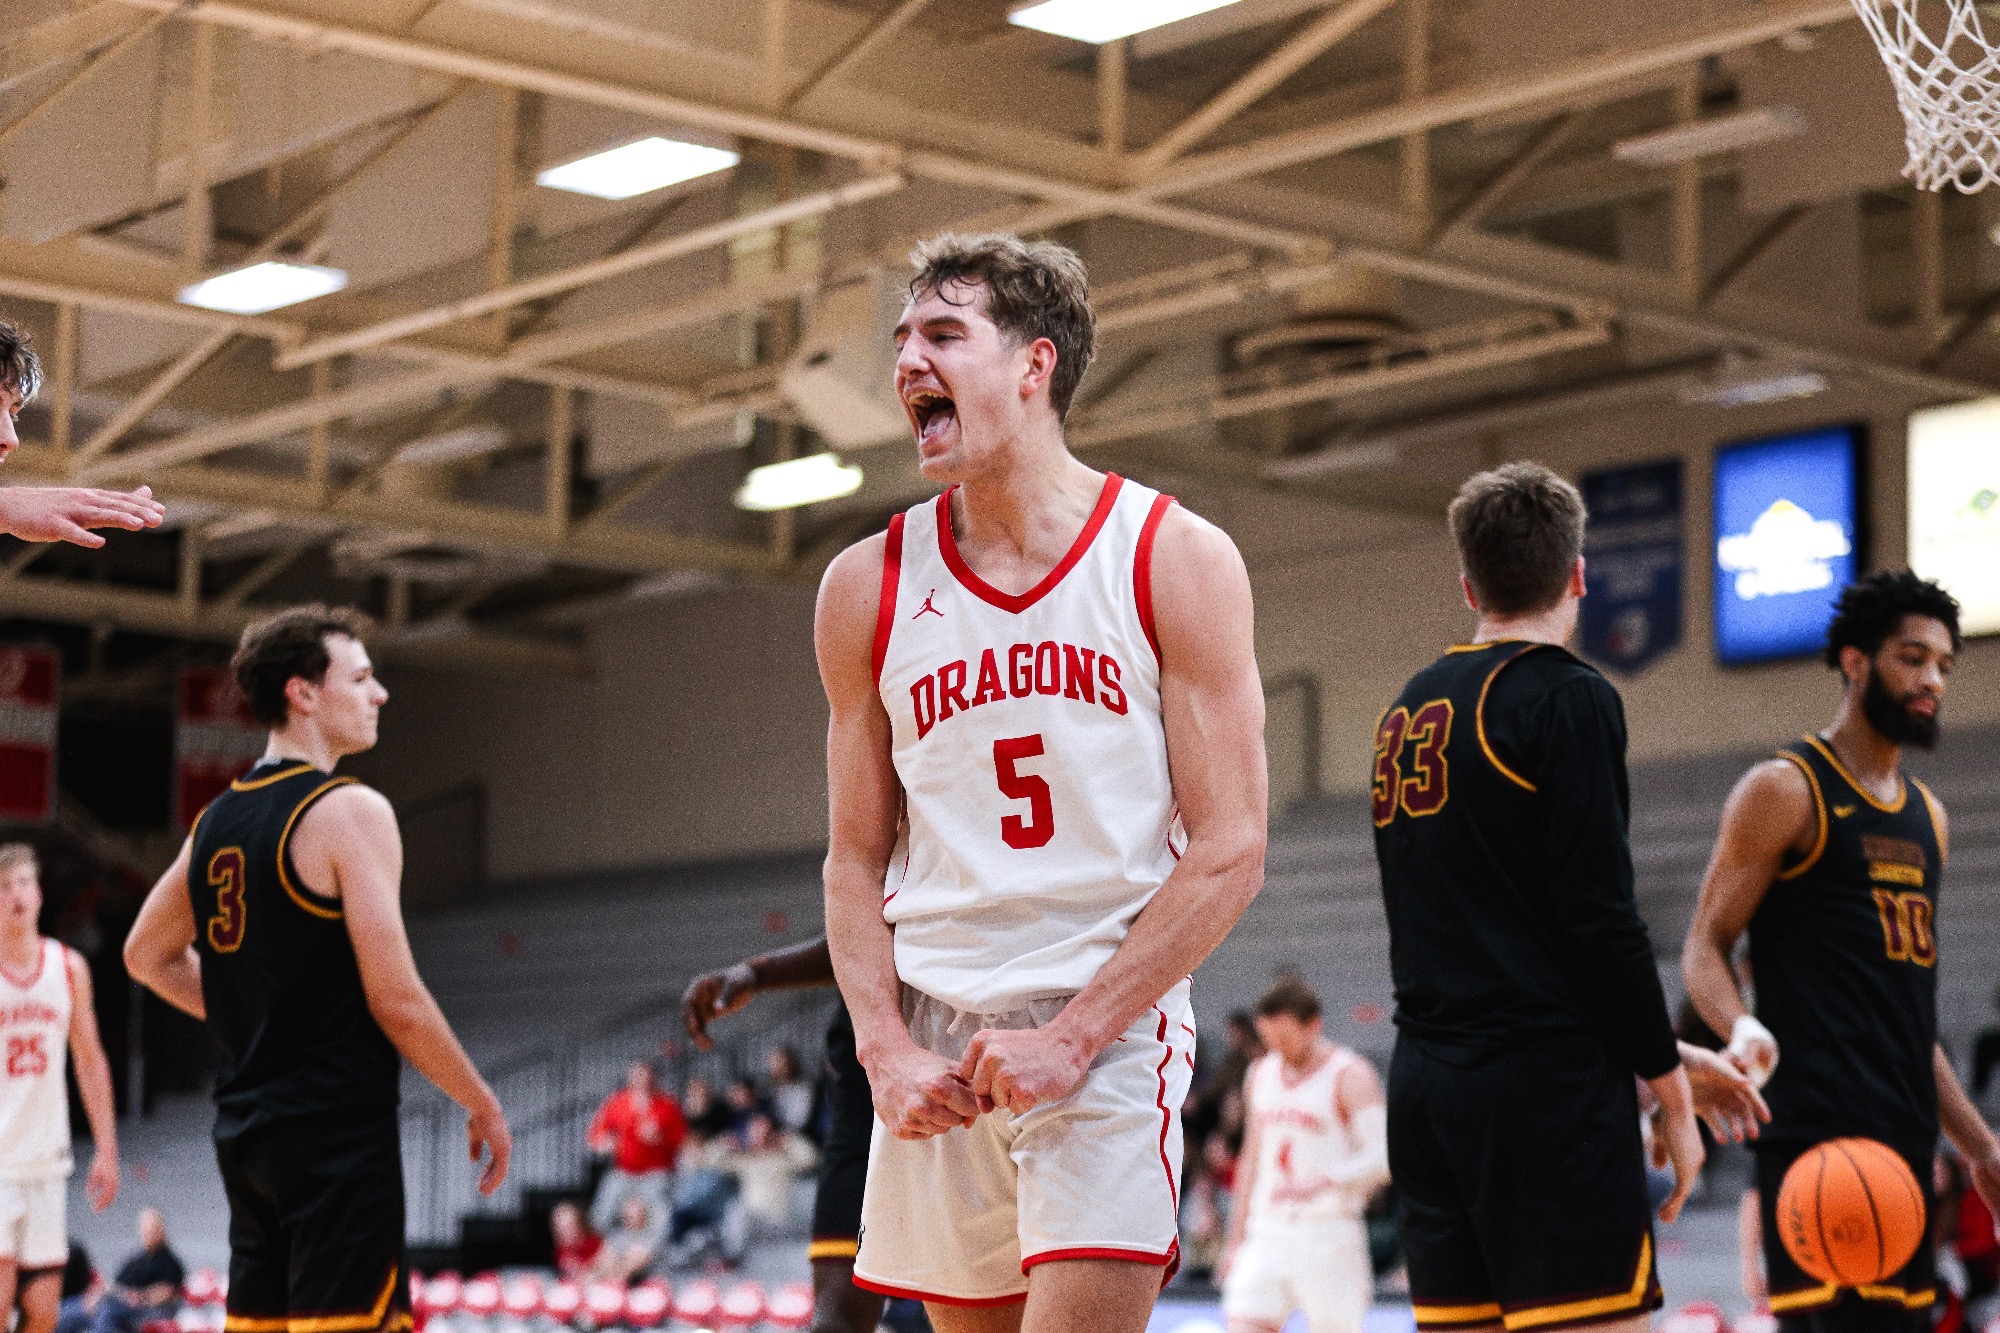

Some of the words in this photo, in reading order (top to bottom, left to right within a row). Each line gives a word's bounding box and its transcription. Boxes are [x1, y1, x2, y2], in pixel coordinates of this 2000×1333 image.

[910, 640, 1129, 741] DRAGONS
[993, 733, 1055, 849] 5
[1373, 698, 1454, 828] 33
[207, 846, 246, 954] 3
[1871, 886, 1936, 969] 10
[7, 1035, 48, 1078] 25
